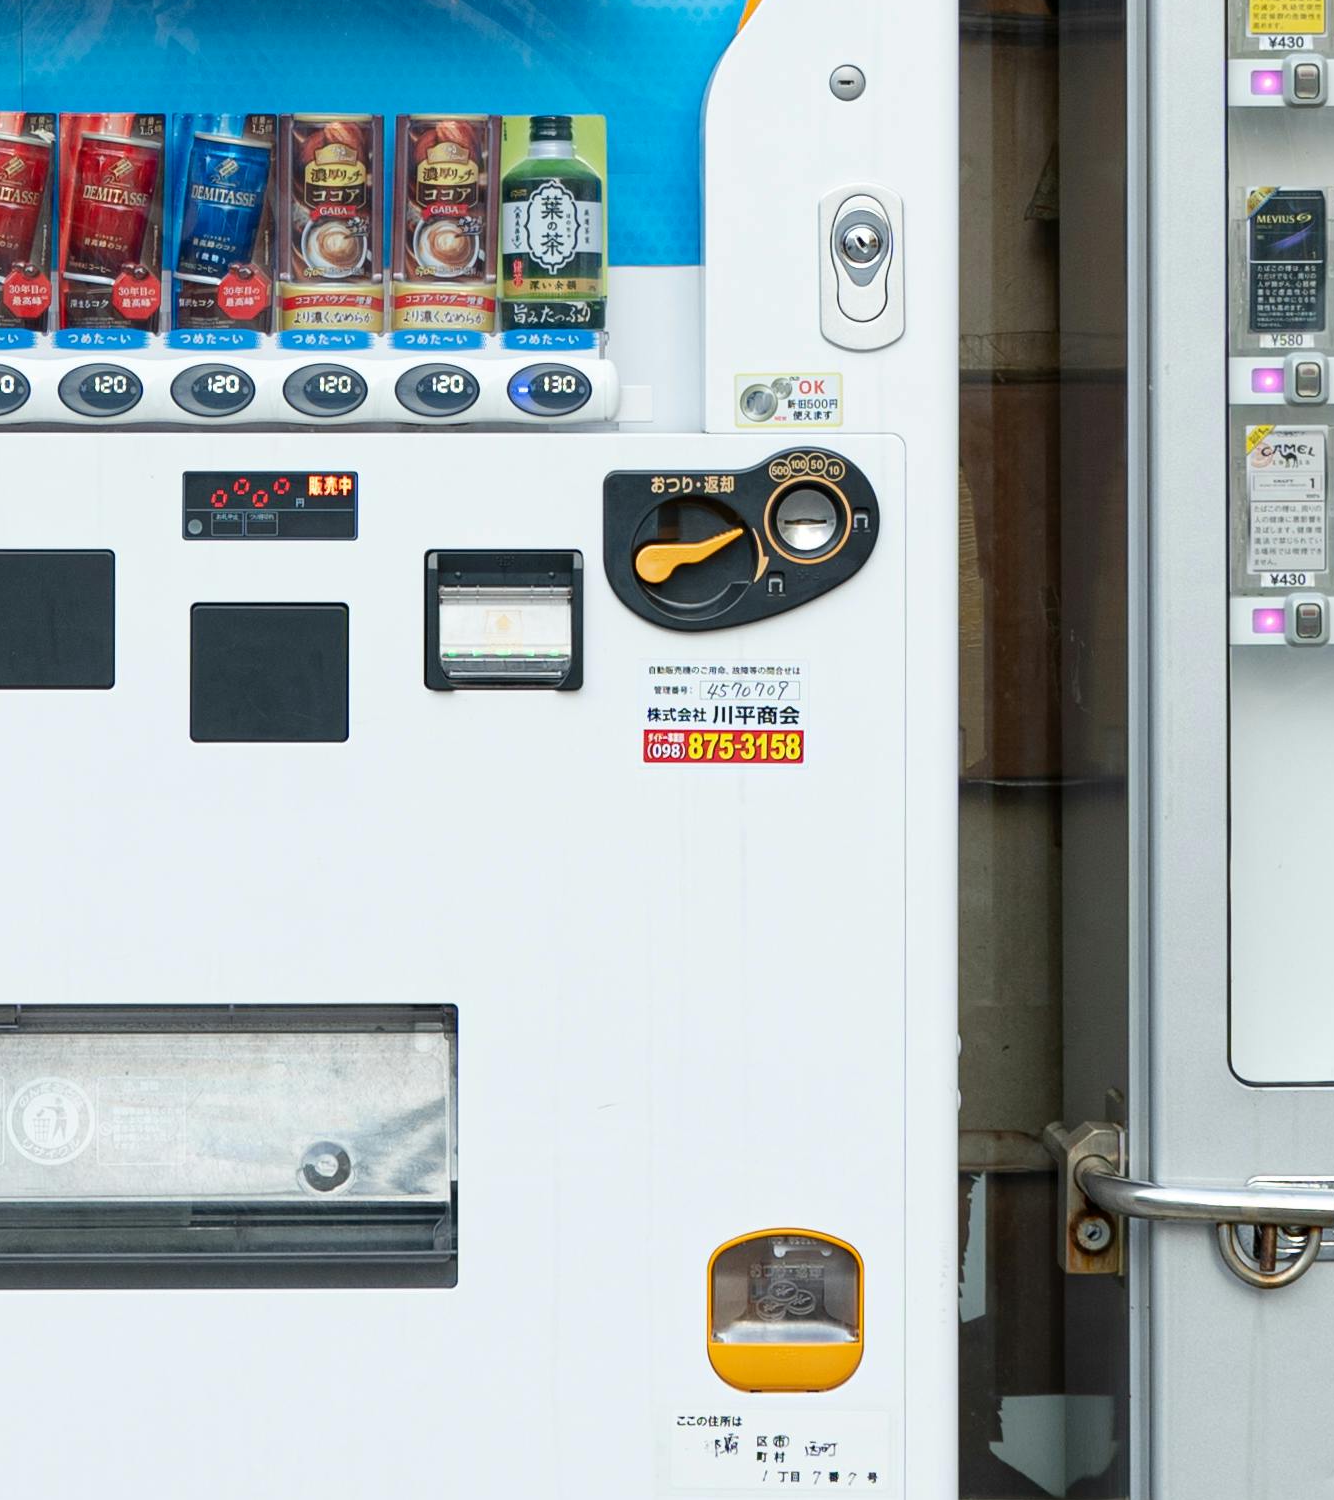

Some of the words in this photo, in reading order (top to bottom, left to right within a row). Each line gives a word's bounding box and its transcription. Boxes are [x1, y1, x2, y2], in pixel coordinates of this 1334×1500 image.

[311, 167, 363, 184] 濃厚リッチ
[83, 183, 149, 207] DEMITASSE
[191, 184, 256, 207] DEMITASSE
[312, 188, 360, 203] ココア
[423, 188, 472, 202] ココア
[319, 207, 348, 215] GABA
[430, 205, 459, 215] GABA
[540, 195, 565, 257] 葉の茶
[1256, 214, 1295, 224] MEVIUS
[513, 304, 591, 325] 旨みたっぷり
[1271, 334, 1305, 346] ¥580
[543, 376, 575, 394] 130
[799, 380, 825, 395] OK
[793, 410, 833, 421] 使えます
[771, 464, 789, 476] 500
[791, 459, 806, 470] 100
[811, 459, 823, 470] 50
[829, 465, 840, 476] 10
[308, 476, 353, 496] 販売中
[651, 476, 735, 494] おつり・返却
[707, 681, 789, 700] 4570709
[647, 707, 707, 722] 株式会社
[713, 706, 800, 725] 川平商会
[647, 743, 686, 759] (098)
[688, 732, 801, 760] 875-3158
[677, 1416, 743, 1427] ここの住所は
